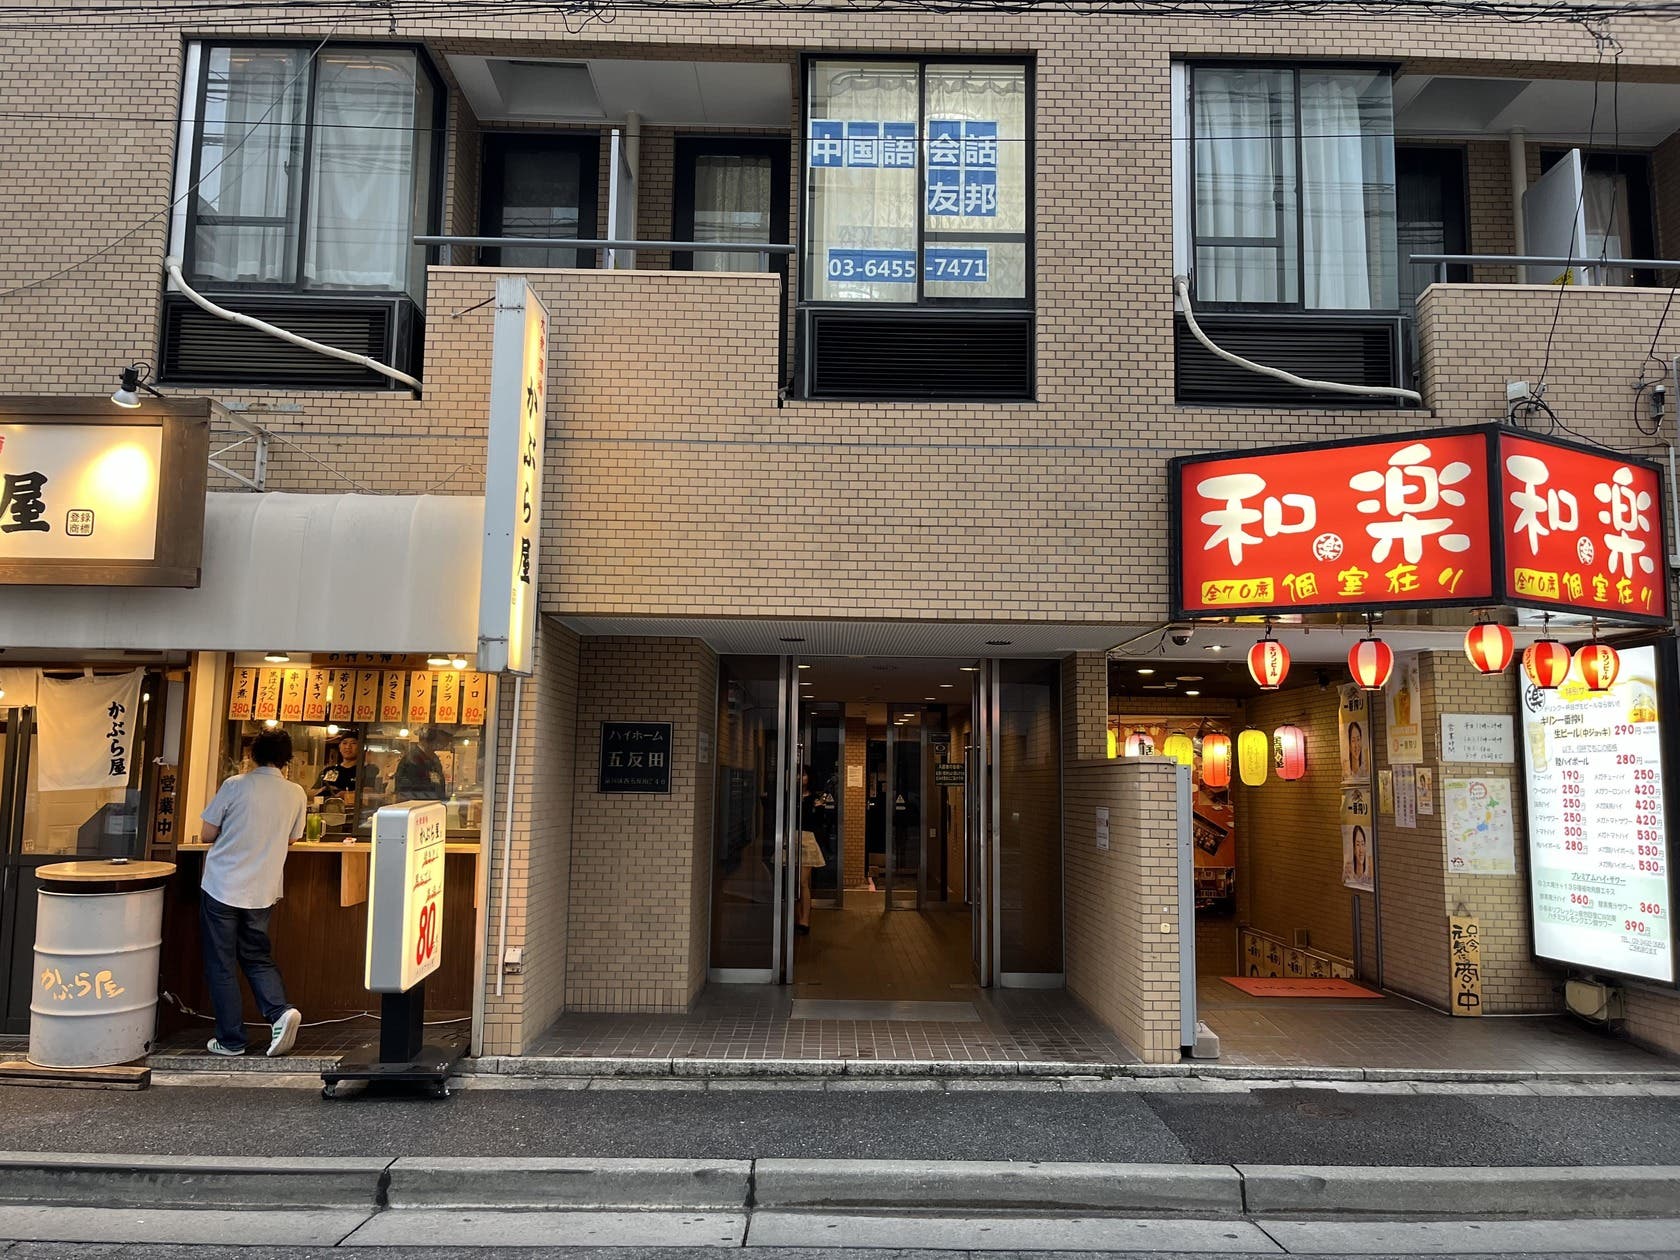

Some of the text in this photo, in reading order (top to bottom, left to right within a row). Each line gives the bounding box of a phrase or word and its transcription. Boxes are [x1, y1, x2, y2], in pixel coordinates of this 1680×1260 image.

[929, 182, 996, 213] 友邦
[518, 376, 538, 584] かぶら屋
[0, 471, 50, 534] 屋
[1197, 443, 1472, 567] 和楽
[1506, 455, 1655, 579] 和楽
[1282, 562, 1464, 603] 個室在り
[1562, 572, 1652, 610] 個室在り
[1269, 646, 1278, 677] キリンビール
[1600, 650, 1609, 680] キリンビール
[289, 672, 299, 697] 串かつ
[312, 671, 323, 700] ネギマ
[363, 673, 372, 696] タン
[389, 673, 399, 700] ハラミ
[417, 674, 426, 697] ハツ
[444, 674, 454, 701] カシラ
[471, 675, 480, 698] シロ
[106, 701, 127, 776] かぶら屋
[609, 730, 664, 741] ハイホーム
[608, 751, 664, 768] 五反田
[157, 775, 176, 836] 営業中
[416, 902, 436, 966] 80
[41, 967, 125, 1001] かぶら屋
